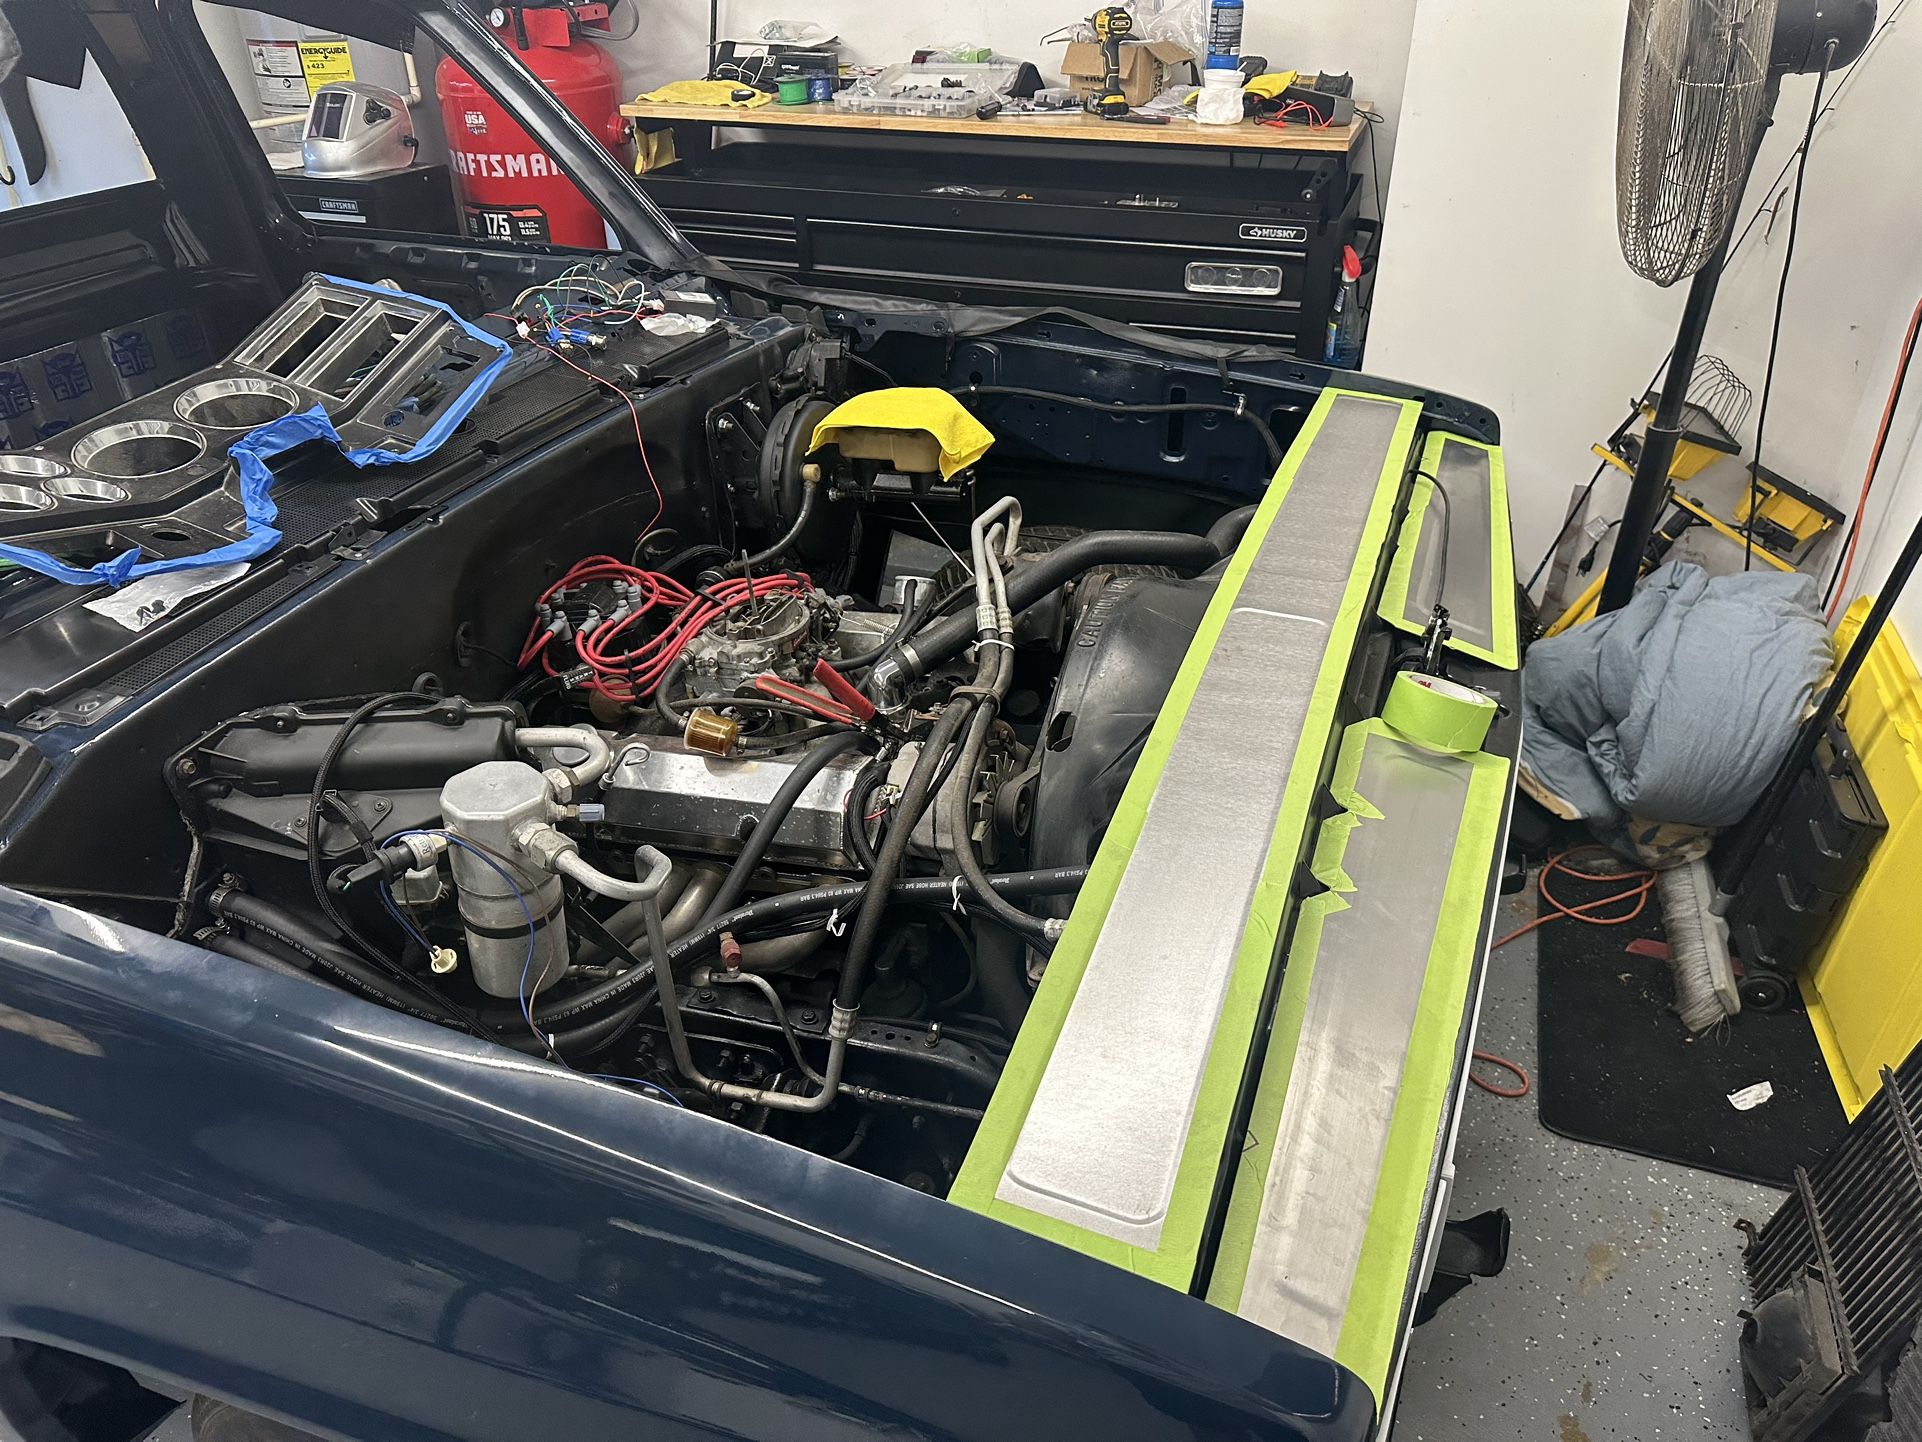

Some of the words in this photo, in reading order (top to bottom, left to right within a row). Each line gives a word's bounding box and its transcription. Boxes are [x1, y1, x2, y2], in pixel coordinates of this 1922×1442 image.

[464, 114, 487, 125] USA
[448, 149, 565, 177] RAFTSMA
[321, 201, 357, 210] CRAFTSMAN
[483, 213, 511, 235] 175
[1261, 228, 1297, 238] HUSKY
[929, 881, 948, 889] HEATER
[277, 933, 294, 946] CHINA
[301, 946, 317, 959] MADE
[668, 943, 688, 958] HEATER
[334, 967, 346, 977] SAE
[346, 974, 363, 987] HOSE
[616, 979, 631, 993] MADE
[362, 983, 385, 999] HEATER
[594, 992, 610, 1004] CHINA
